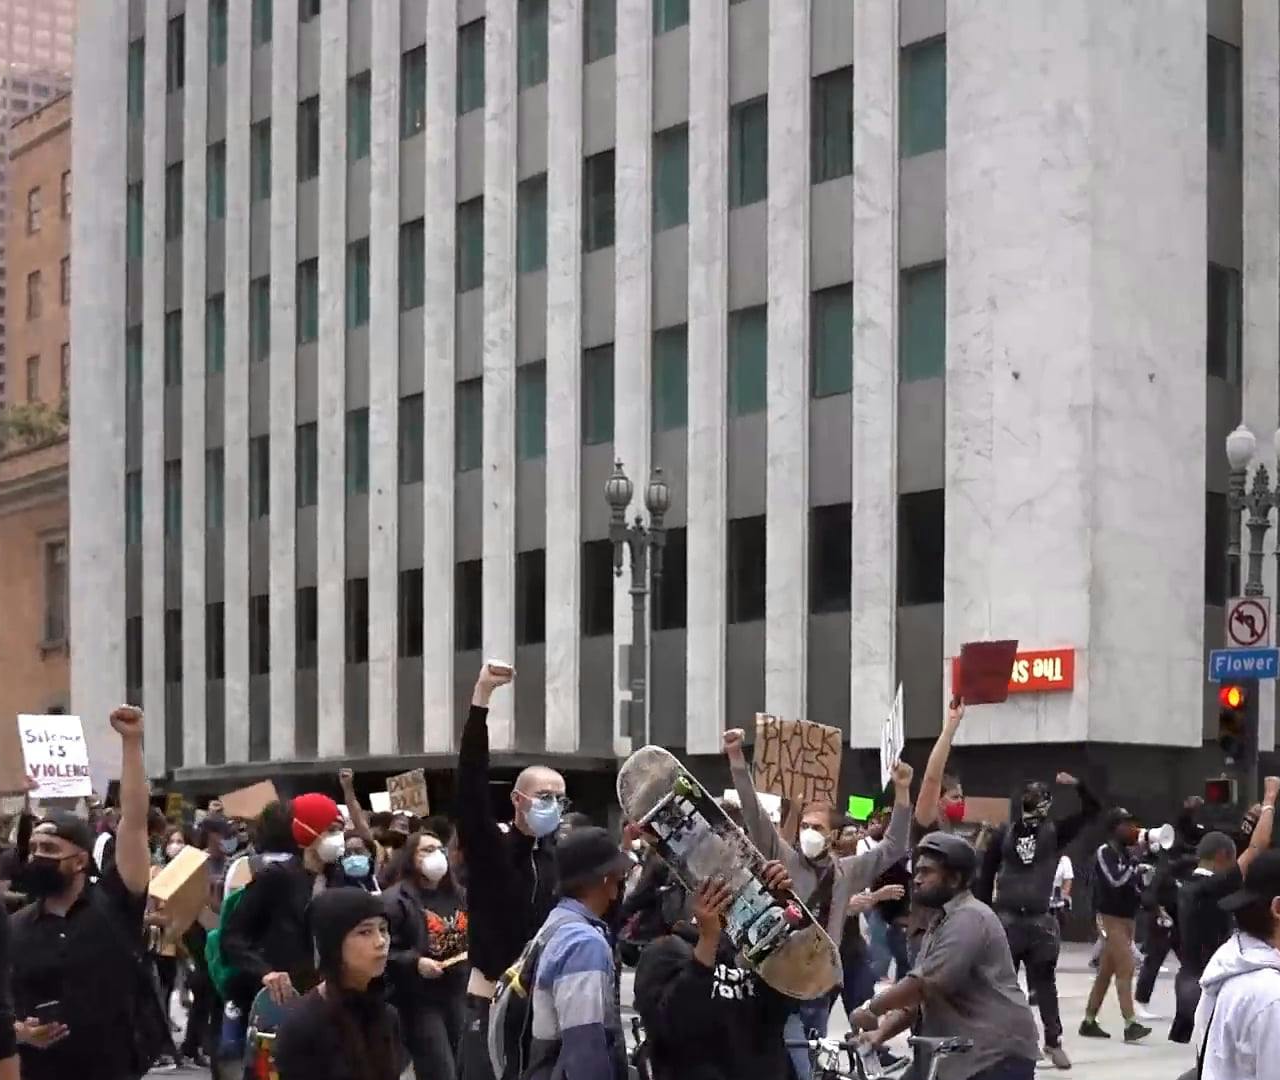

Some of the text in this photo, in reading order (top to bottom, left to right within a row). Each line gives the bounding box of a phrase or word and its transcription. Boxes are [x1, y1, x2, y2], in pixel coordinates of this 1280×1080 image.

[1032, 657, 1063, 682] The
[1215, 655, 1274, 672] Flower
[762, 715, 840, 755] BLACK
[762, 740, 830, 778] LIVES
